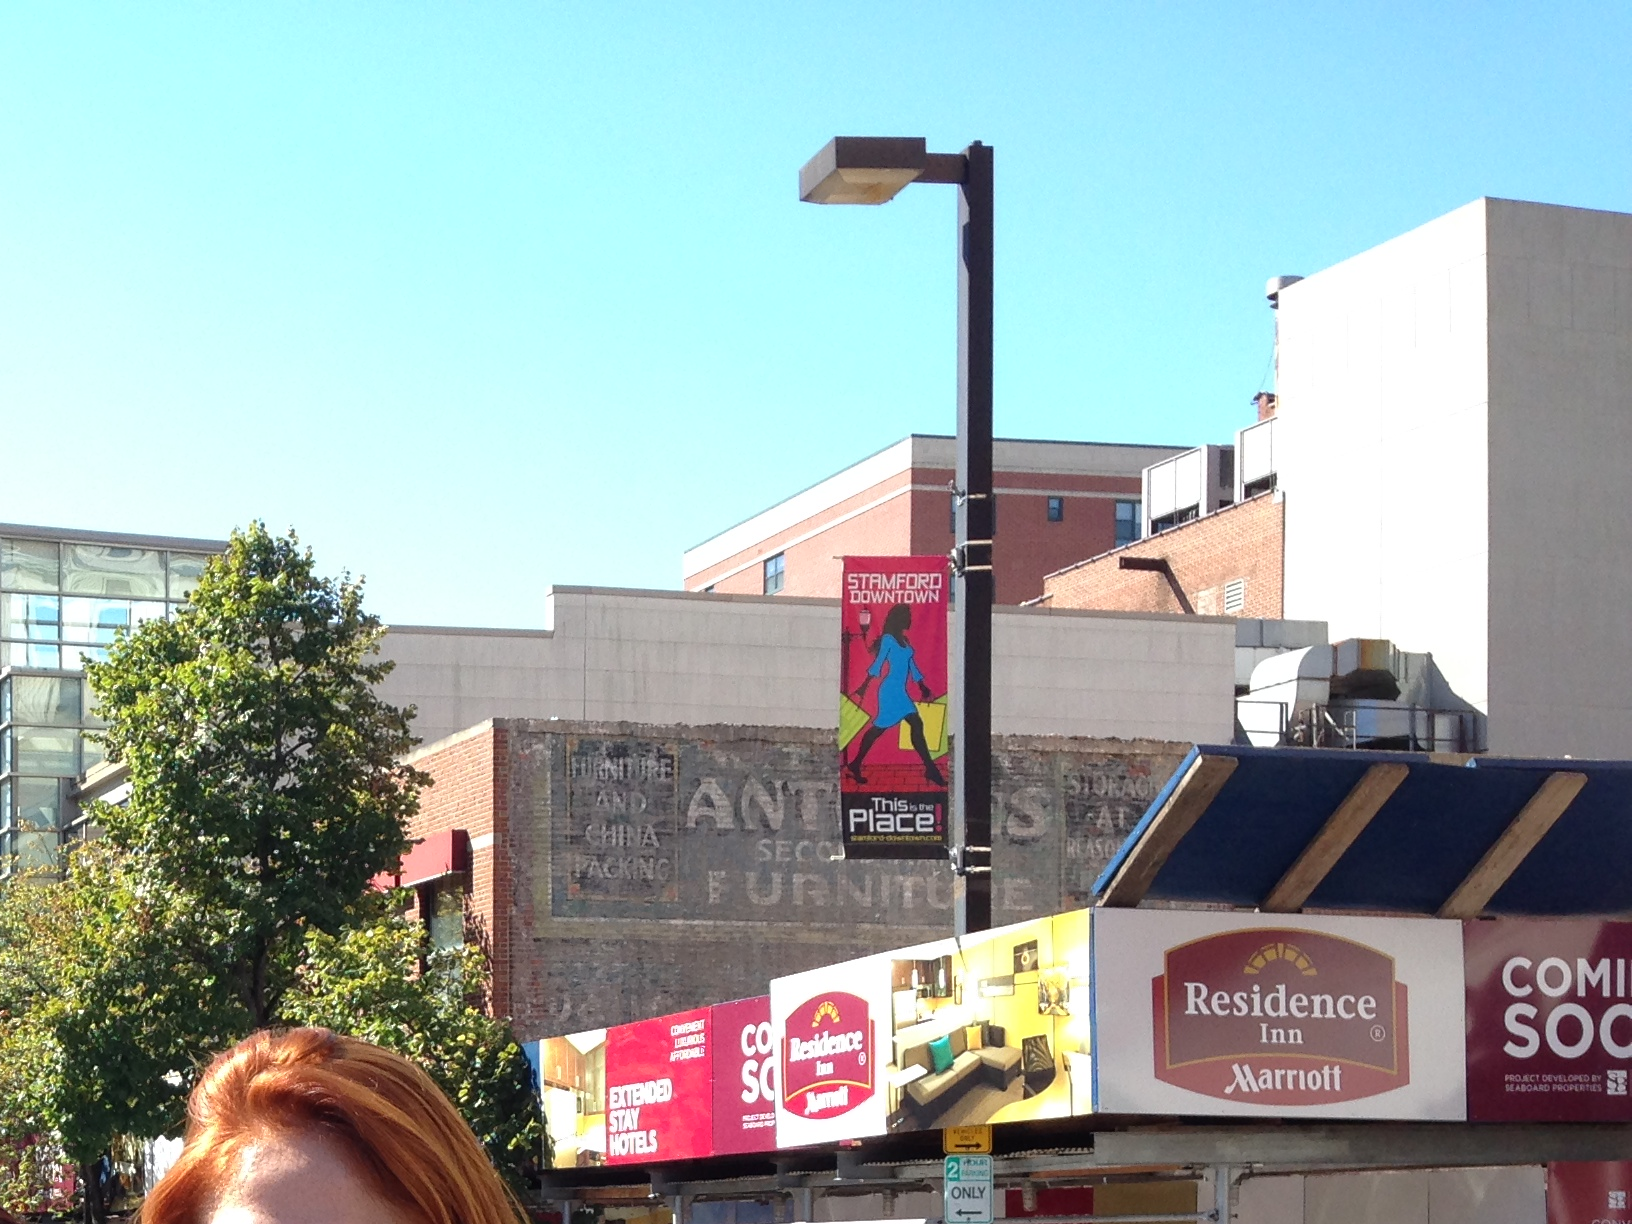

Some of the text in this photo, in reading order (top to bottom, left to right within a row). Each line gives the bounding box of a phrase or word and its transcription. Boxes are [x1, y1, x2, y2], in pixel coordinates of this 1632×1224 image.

[848, 573, 941, 590] STAMFORD
[850, 589, 939, 603] DOWNTOWN
[597, 792, 647, 814] AND
[871, 797, 934, 812] This is the
[849, 804, 942, 832] Place!
[585, 824, 660, 848] CHINA
[576, 857, 671, 881] PACKING
[1502, 956, 1632, 998] COMI
[1184, 983, 1377, 1020] Residence
[1260, 1023, 1304, 1045] Inn
[1503, 1002, 1632, 1059] SOO
[790, 1030, 863, 1062] Residence
[1225, 1063, 1342, 1094] Marriott
[1504, 1074, 1602, 1082] PROJECT DEVELOPED BY
[1505, 1083, 1602, 1092] SEABOARD PROPERTIES
[609, 1078, 672, 1109] EXTENDED
[609, 1108, 640, 1132] STAY
[609, 1129, 657, 1156] HOTELS
[948, 1161, 958, 1178] 2
[951, 1186, 986, 1200] ONLY
